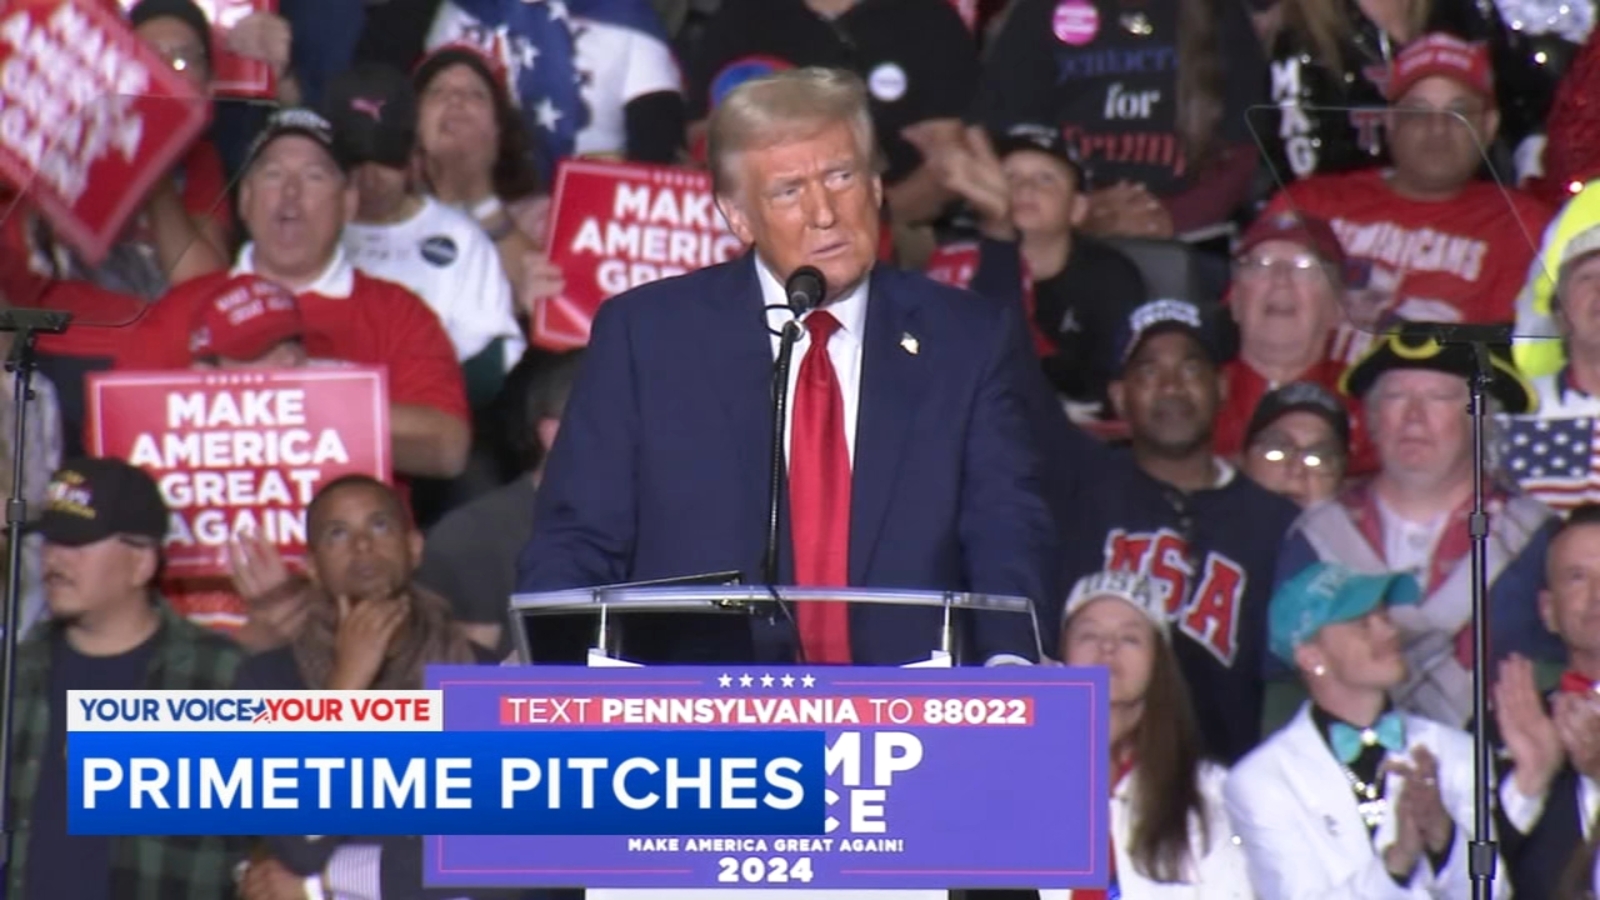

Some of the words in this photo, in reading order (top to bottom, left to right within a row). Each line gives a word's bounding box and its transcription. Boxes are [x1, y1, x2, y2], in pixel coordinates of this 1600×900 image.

[1104, 81, 1161, 120] for
[572, 218, 743, 266] AMERIC
[167, 389, 306, 428] MAKE
[128, 428, 349, 469] AMERICA
[157, 469, 321, 507] GREAT
[163, 508, 307, 546] AGAIN
[508, 698, 592, 723] TEXT
[602, 698, 860, 724] PENNSYLVANIA
[869, 698, 913, 724] TO
[923, 698, 1027, 725] 88022
[628, 838, 679, 852] MAKE
[685, 838, 768, 852] AMERICA
[774, 838, 833, 852] GREAT
[839, 838, 904, 852] AGAIN!
[717, 857, 814, 883] 2024
